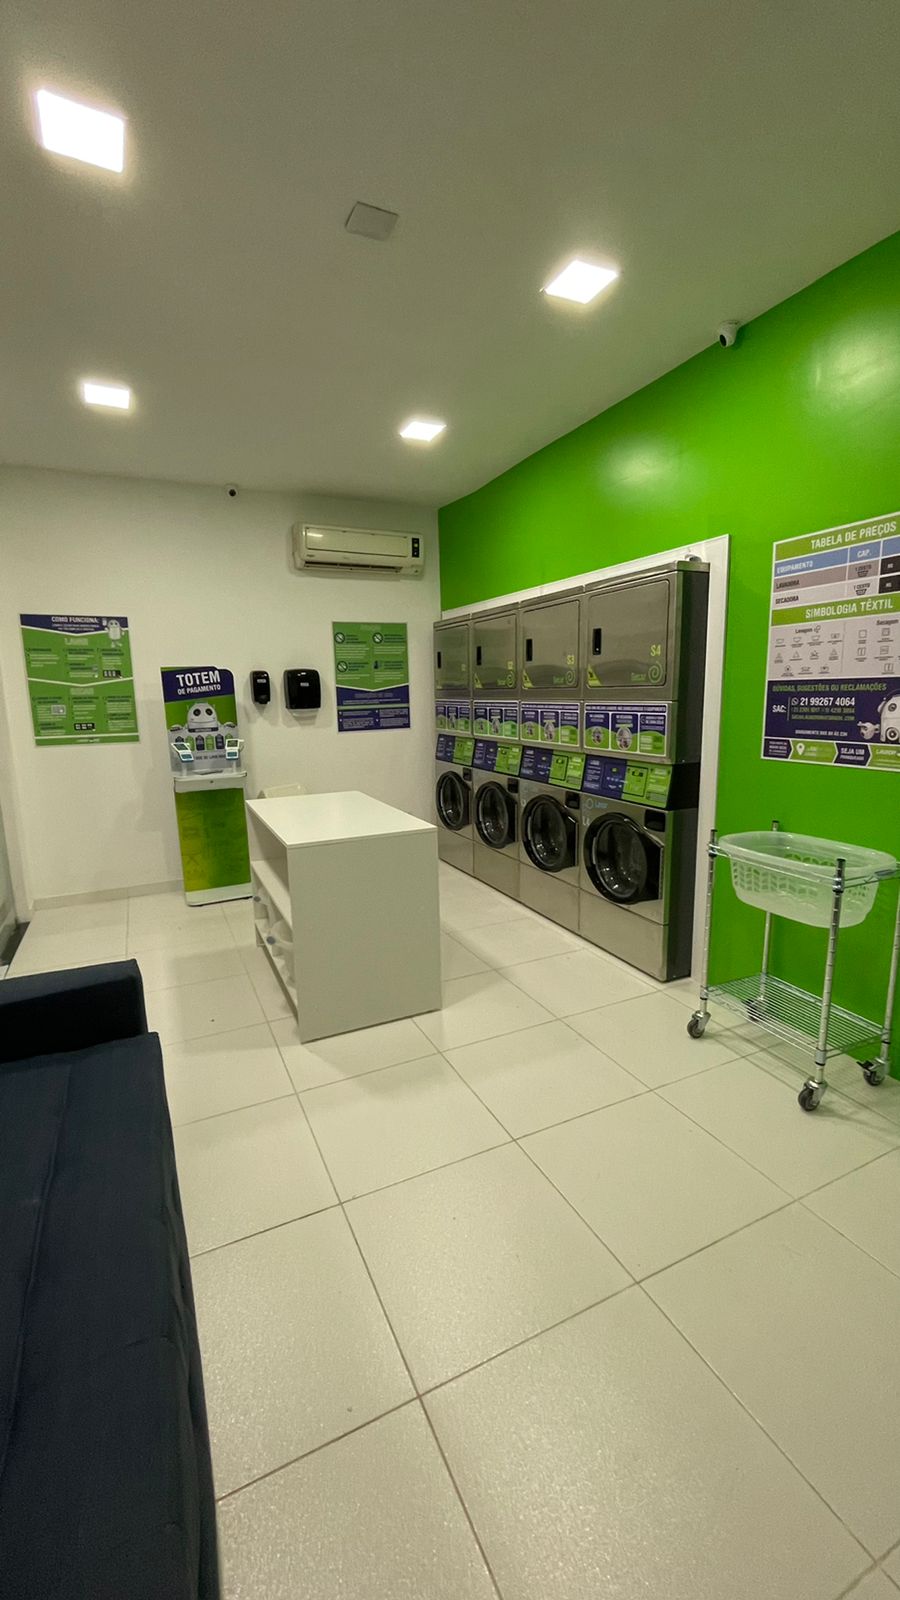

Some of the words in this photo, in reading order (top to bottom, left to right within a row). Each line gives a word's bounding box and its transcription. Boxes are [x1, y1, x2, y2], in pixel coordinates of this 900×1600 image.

[811, 535, 842, 549] TABELA
[844, 530, 857, 542] DE
[859, 521, 897, 539] PREÇOS
[805, 603, 858, 618] SIMBOLOGIA
[860, 599, 893, 612] TÊXTIL
[650, 645, 661, 656] S4
[566, 655, 575, 665] S3
[176, 670, 221, 687] TOTEM
[177, 688, 186, 696] DE
[186, 684, 221, 695] PAGAMENTO
[831, 683, 839, 691] OU
[841, 682, 887, 692] RECLAMAÇÕES
[800, 698, 808, 706] 21
[809, 697, 833, 706] 99267
[835, 697, 855, 706] 4064
[841, 747, 855, 755] SEJA
